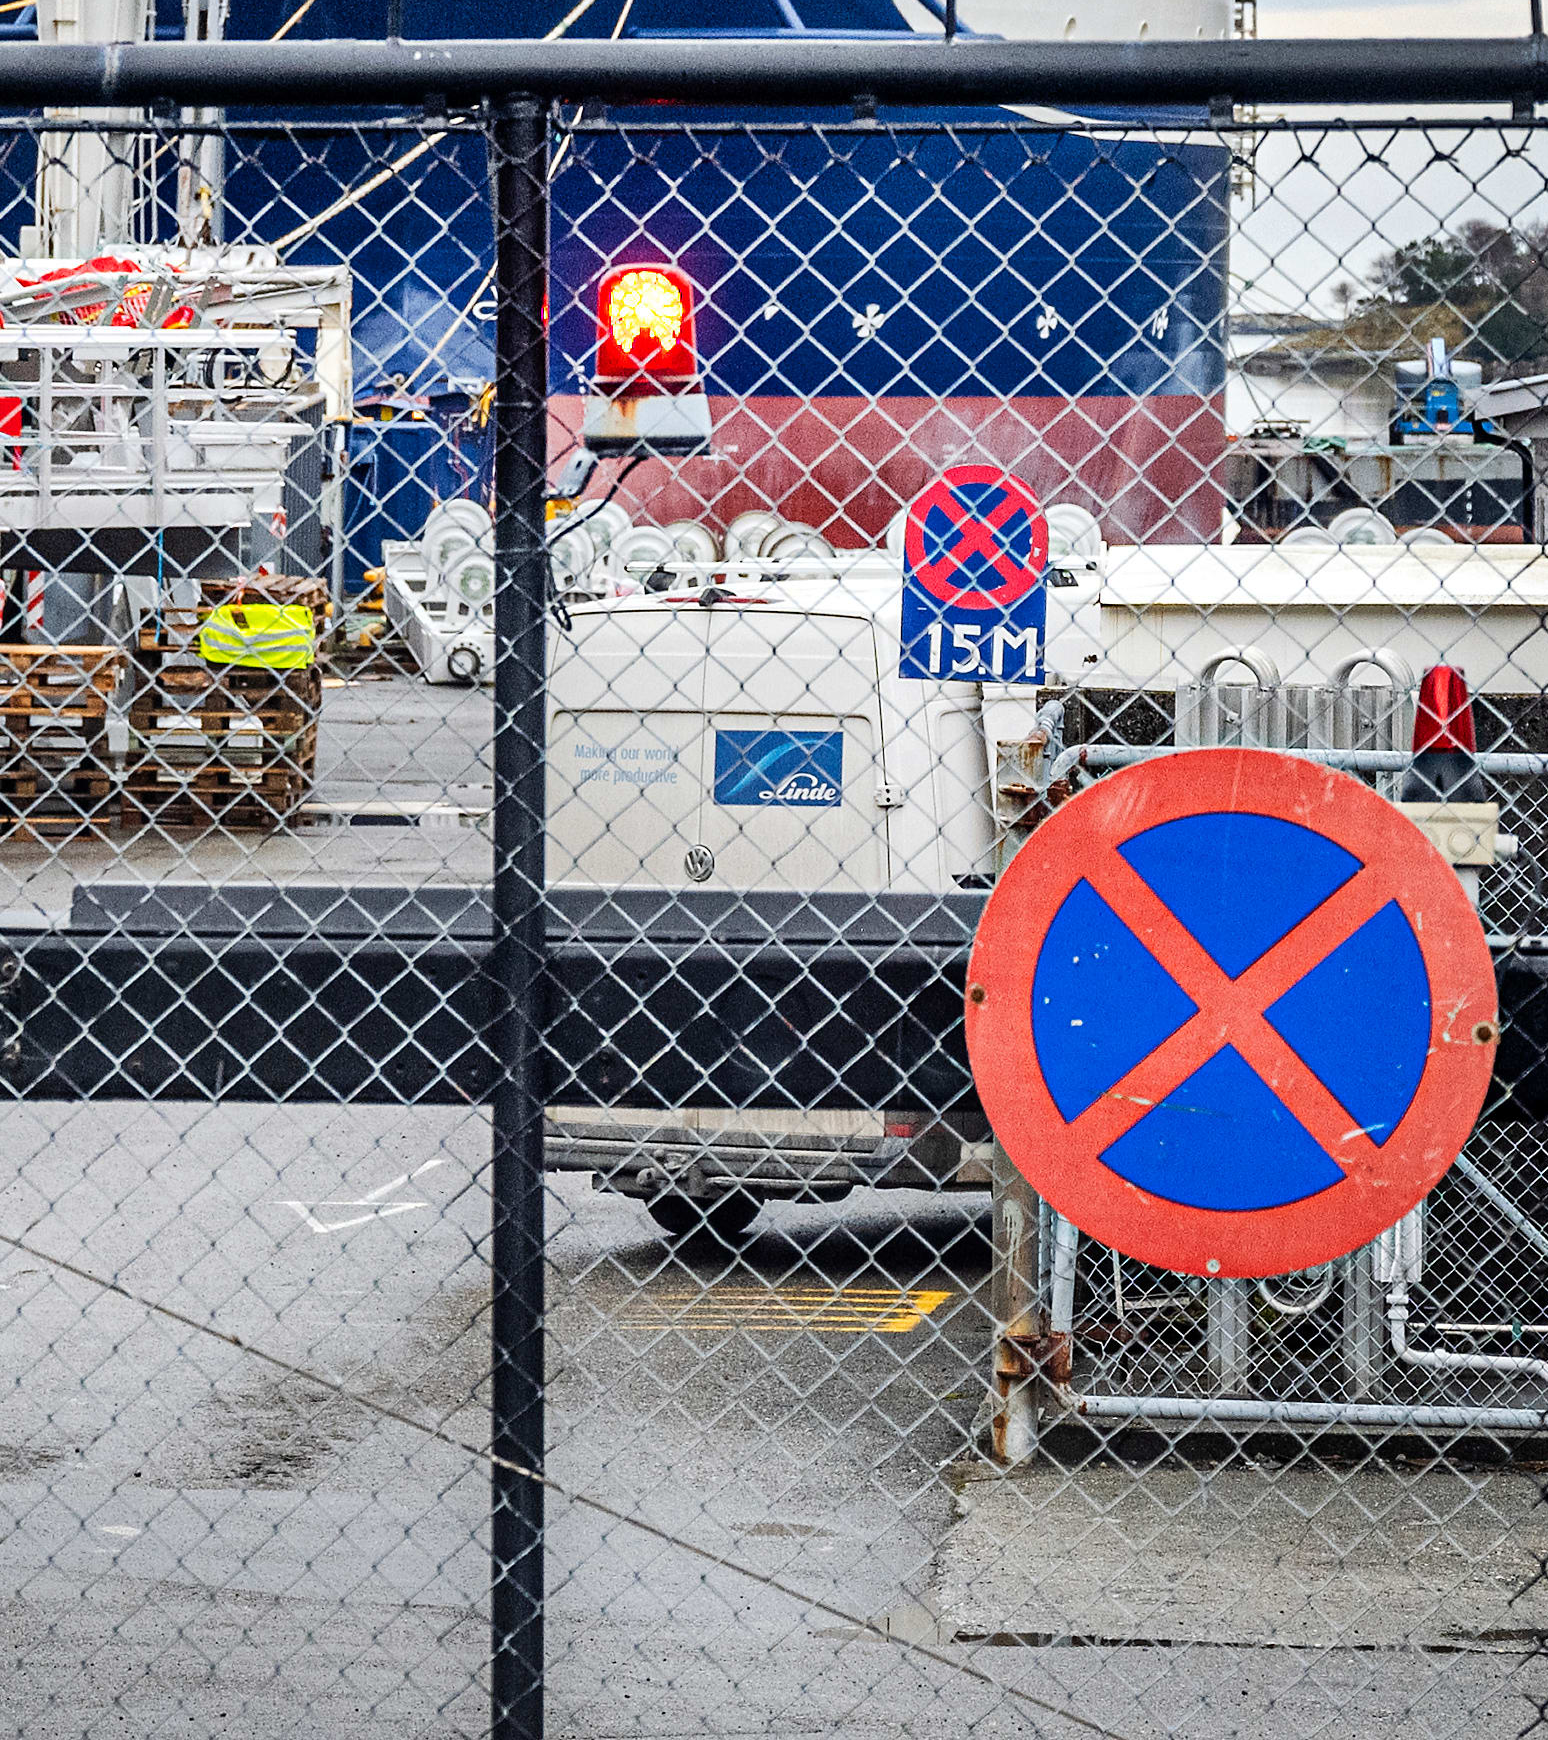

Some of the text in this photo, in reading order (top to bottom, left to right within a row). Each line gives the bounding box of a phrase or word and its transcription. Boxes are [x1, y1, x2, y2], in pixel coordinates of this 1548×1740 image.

[574, 743, 679, 764] Making our world
[580, 768, 678, 786] more productive
[758, 772, 837, 802] Linde
